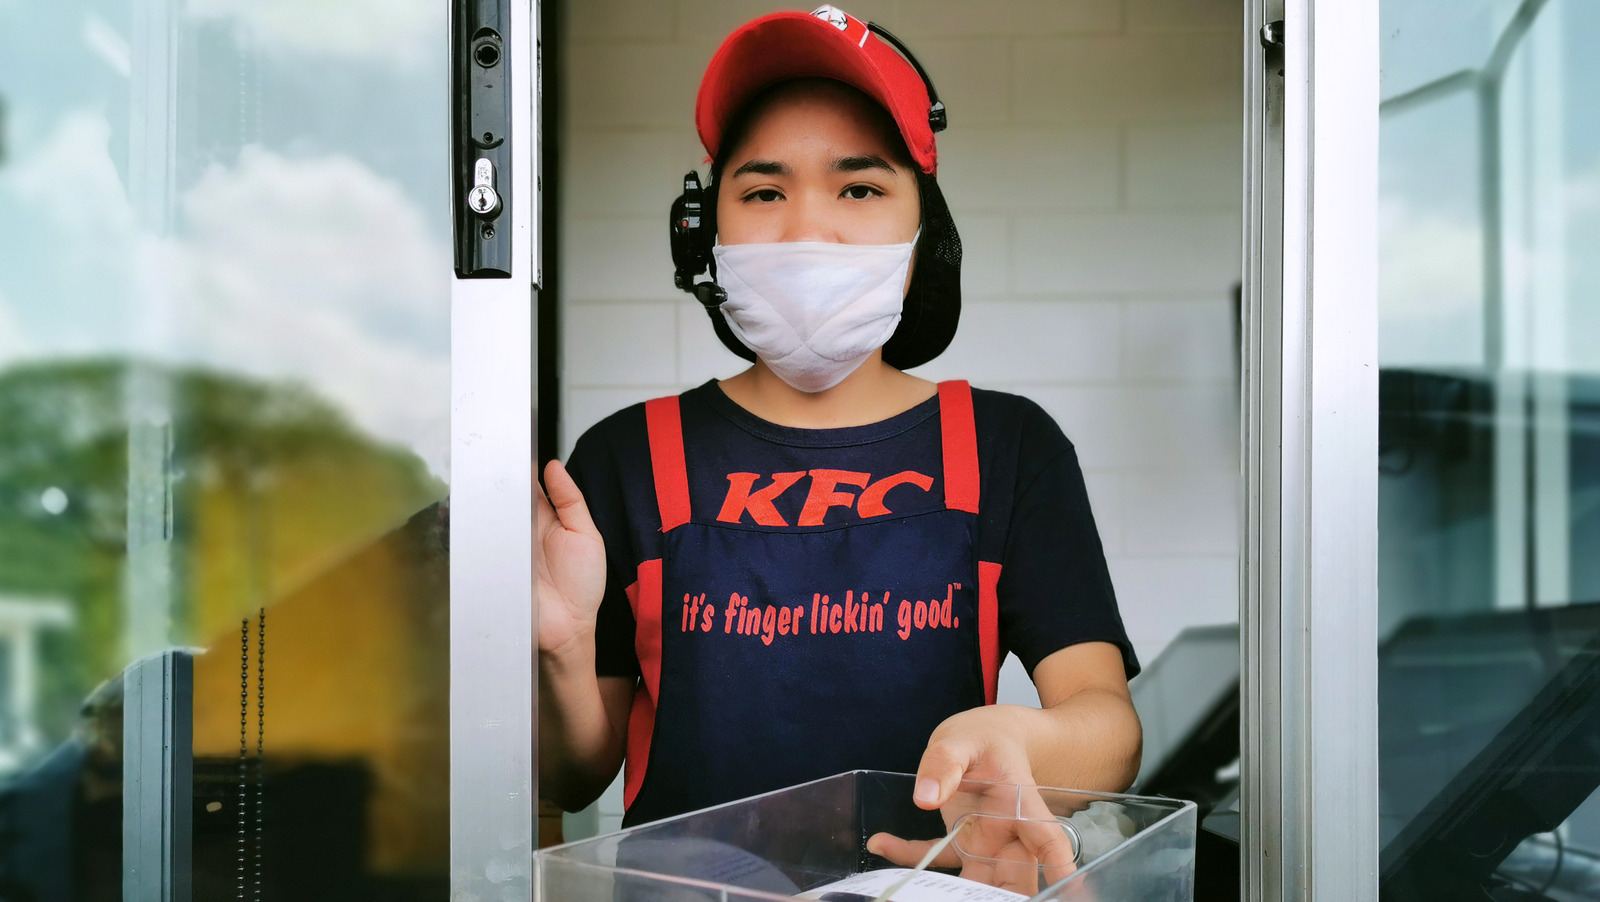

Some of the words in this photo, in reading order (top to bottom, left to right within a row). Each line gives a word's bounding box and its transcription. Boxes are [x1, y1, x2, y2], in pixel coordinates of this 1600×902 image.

[716, 468, 935, 528] KFC
[681, 592, 715, 633] it's
[724, 591, 805, 647] finger
[810, 589, 891, 635] lickin'
